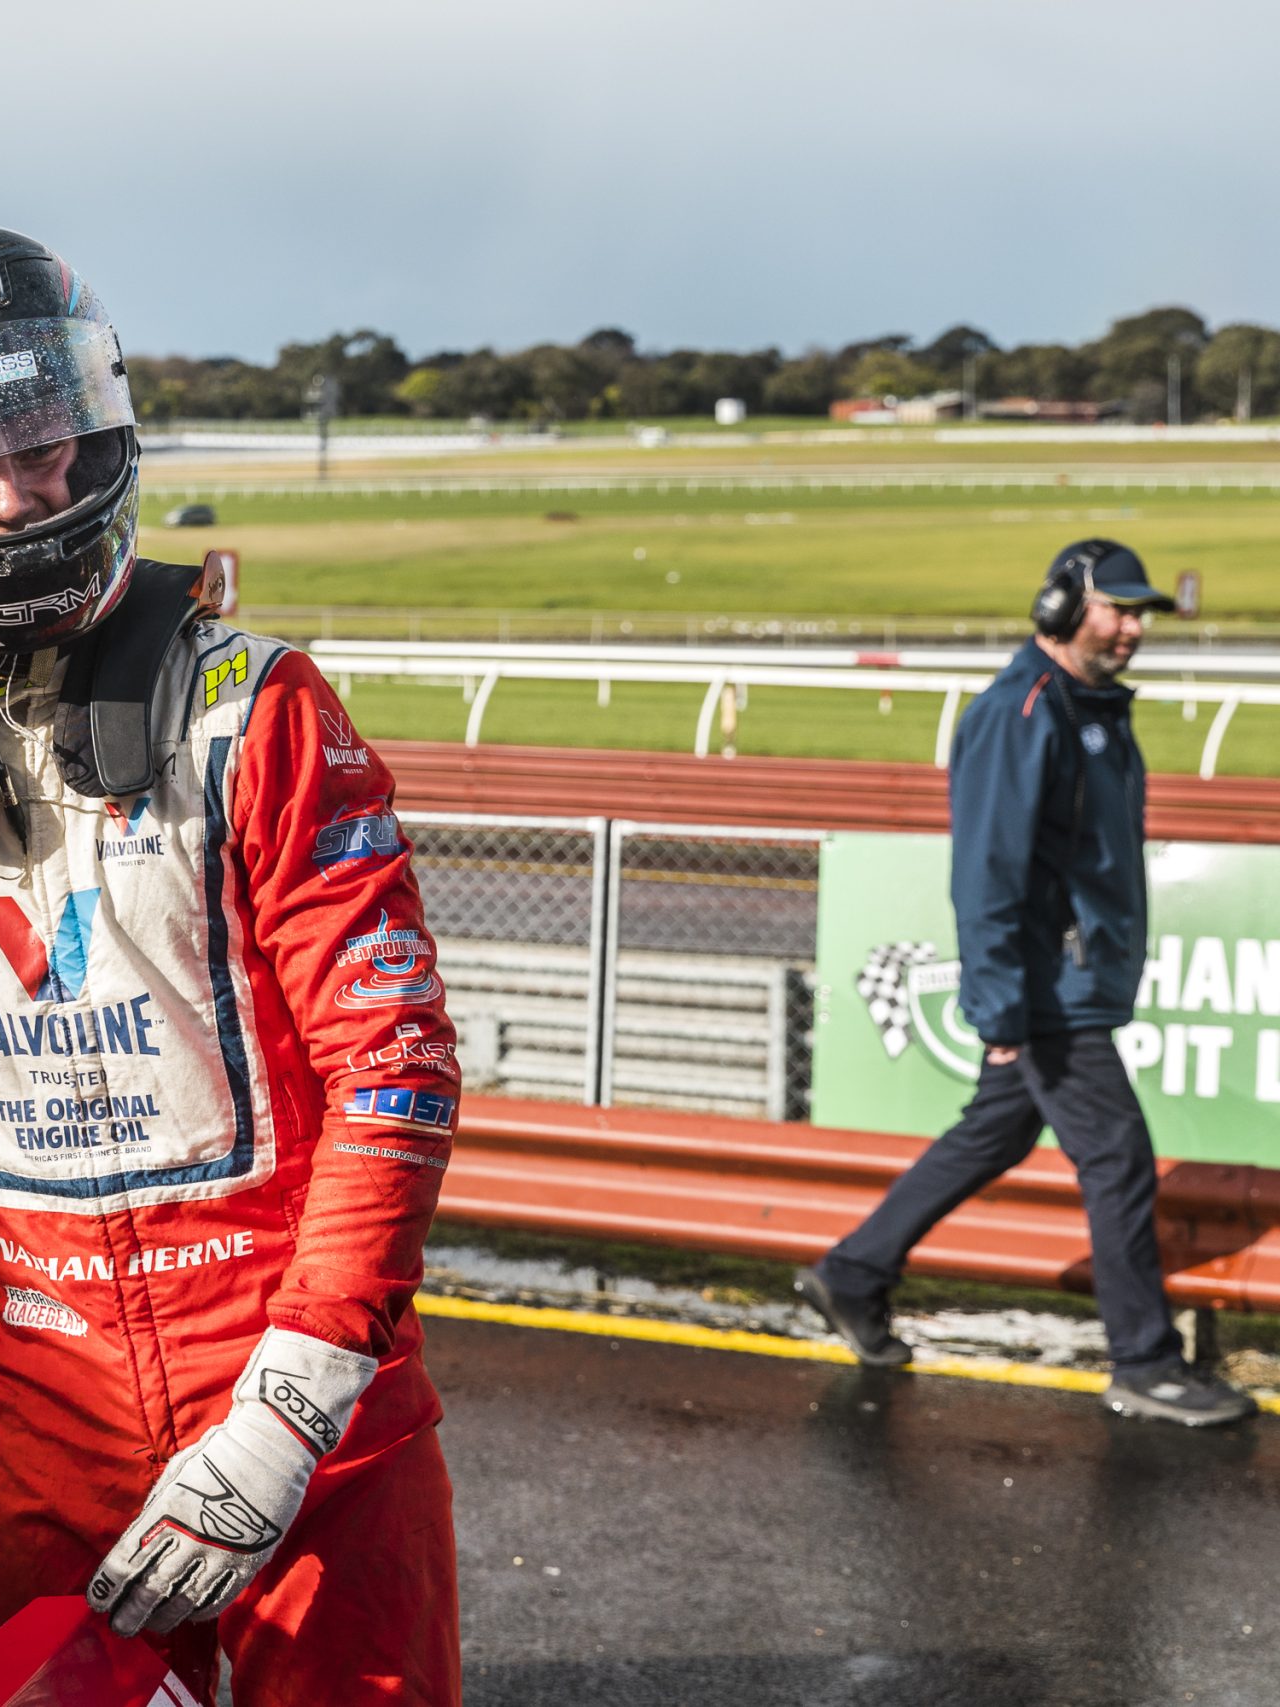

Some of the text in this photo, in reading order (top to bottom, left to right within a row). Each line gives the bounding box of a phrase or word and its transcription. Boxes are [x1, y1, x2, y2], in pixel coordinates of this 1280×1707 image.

[201, 647, 248, 709] P1
[322, 744, 370, 768] VALVOLINE
[96, 834, 165, 861] VALVOLINE
[346, 929, 419, 949] NORTH COAST
[336, 941, 431, 967] PETROLEUM
[1134, 934, 1280, 1017] HAN
[29, 1070, 108, 1089] TRUSTED
[46, 1093, 160, 1123] ORIGINAL
[343, 1087, 456, 1127] JOST
[15, 1120, 150, 1150] ENGINE OIL
[60, 1151, 81, 1160] FIRST
[334, 1142, 379, 1156] LISMORE
[381, 1149, 427, 1164] INFRARED
[128, 1230, 254, 1276] HERNE
